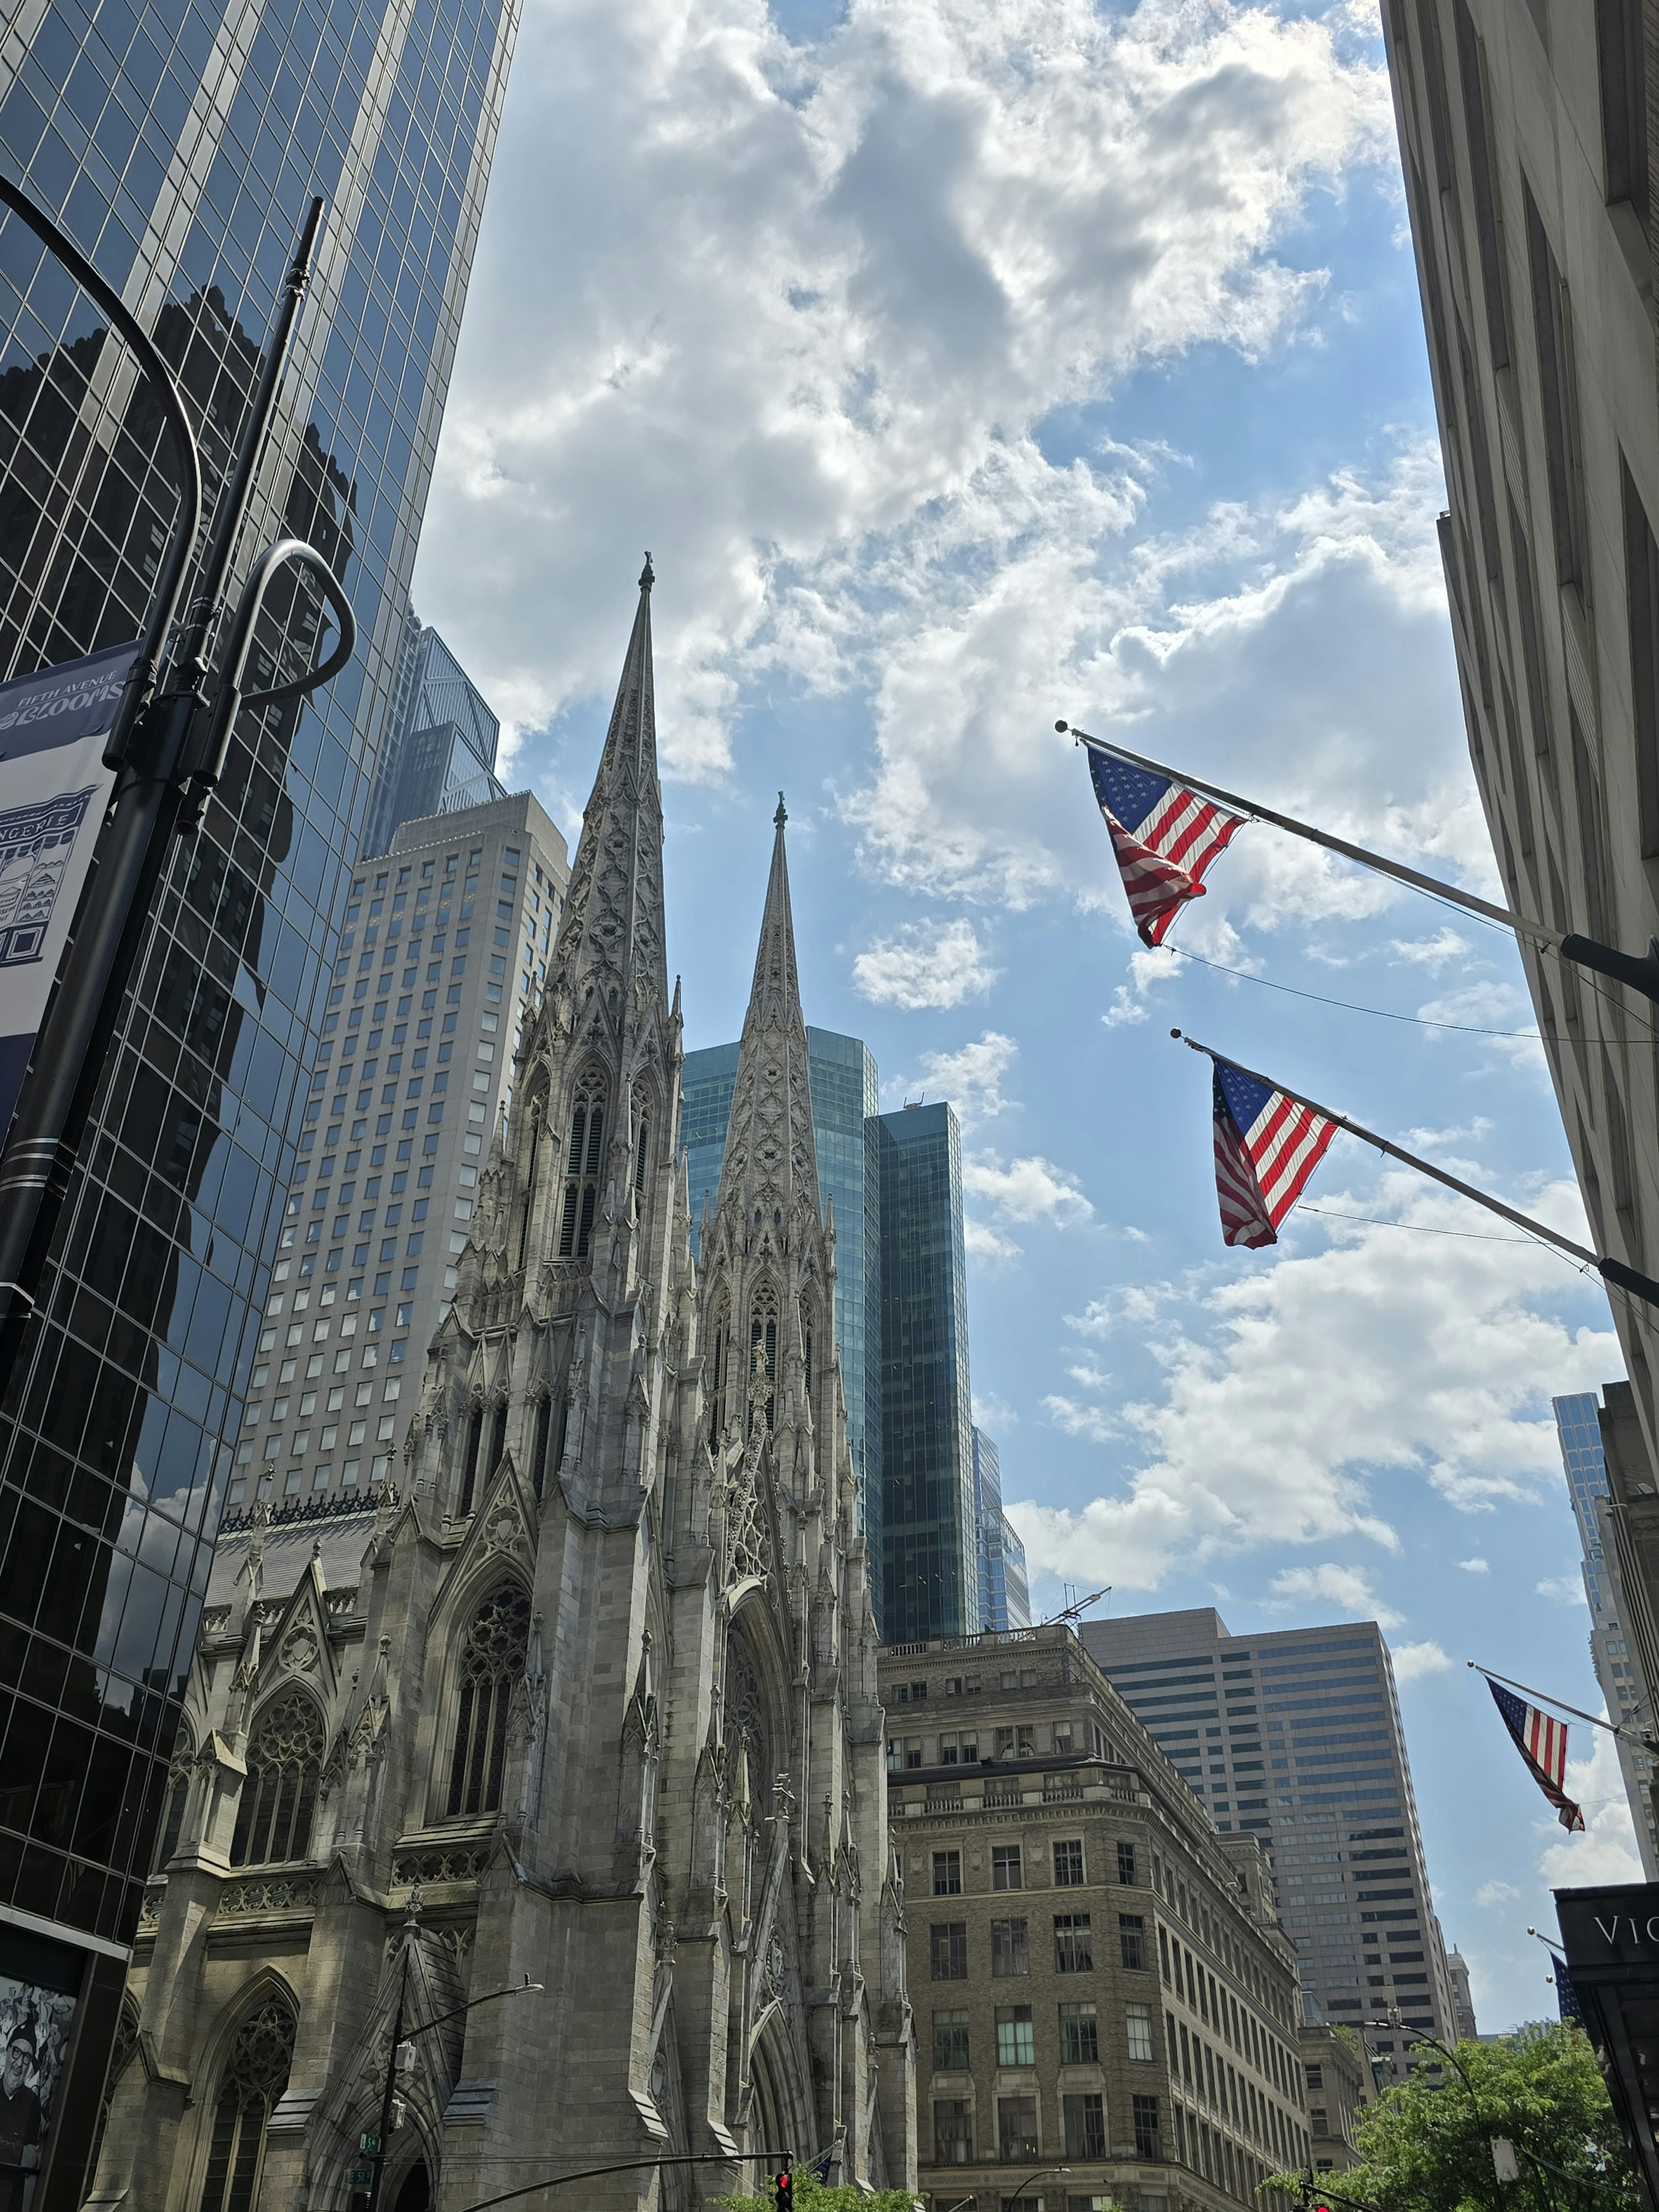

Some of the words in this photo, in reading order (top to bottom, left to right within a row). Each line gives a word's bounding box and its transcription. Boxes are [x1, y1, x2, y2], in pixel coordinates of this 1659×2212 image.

[15, 680, 127, 727] BLOOMS
[18, 688, 60, 708] FIFTH
[61, 670, 118, 696] AVENUE
